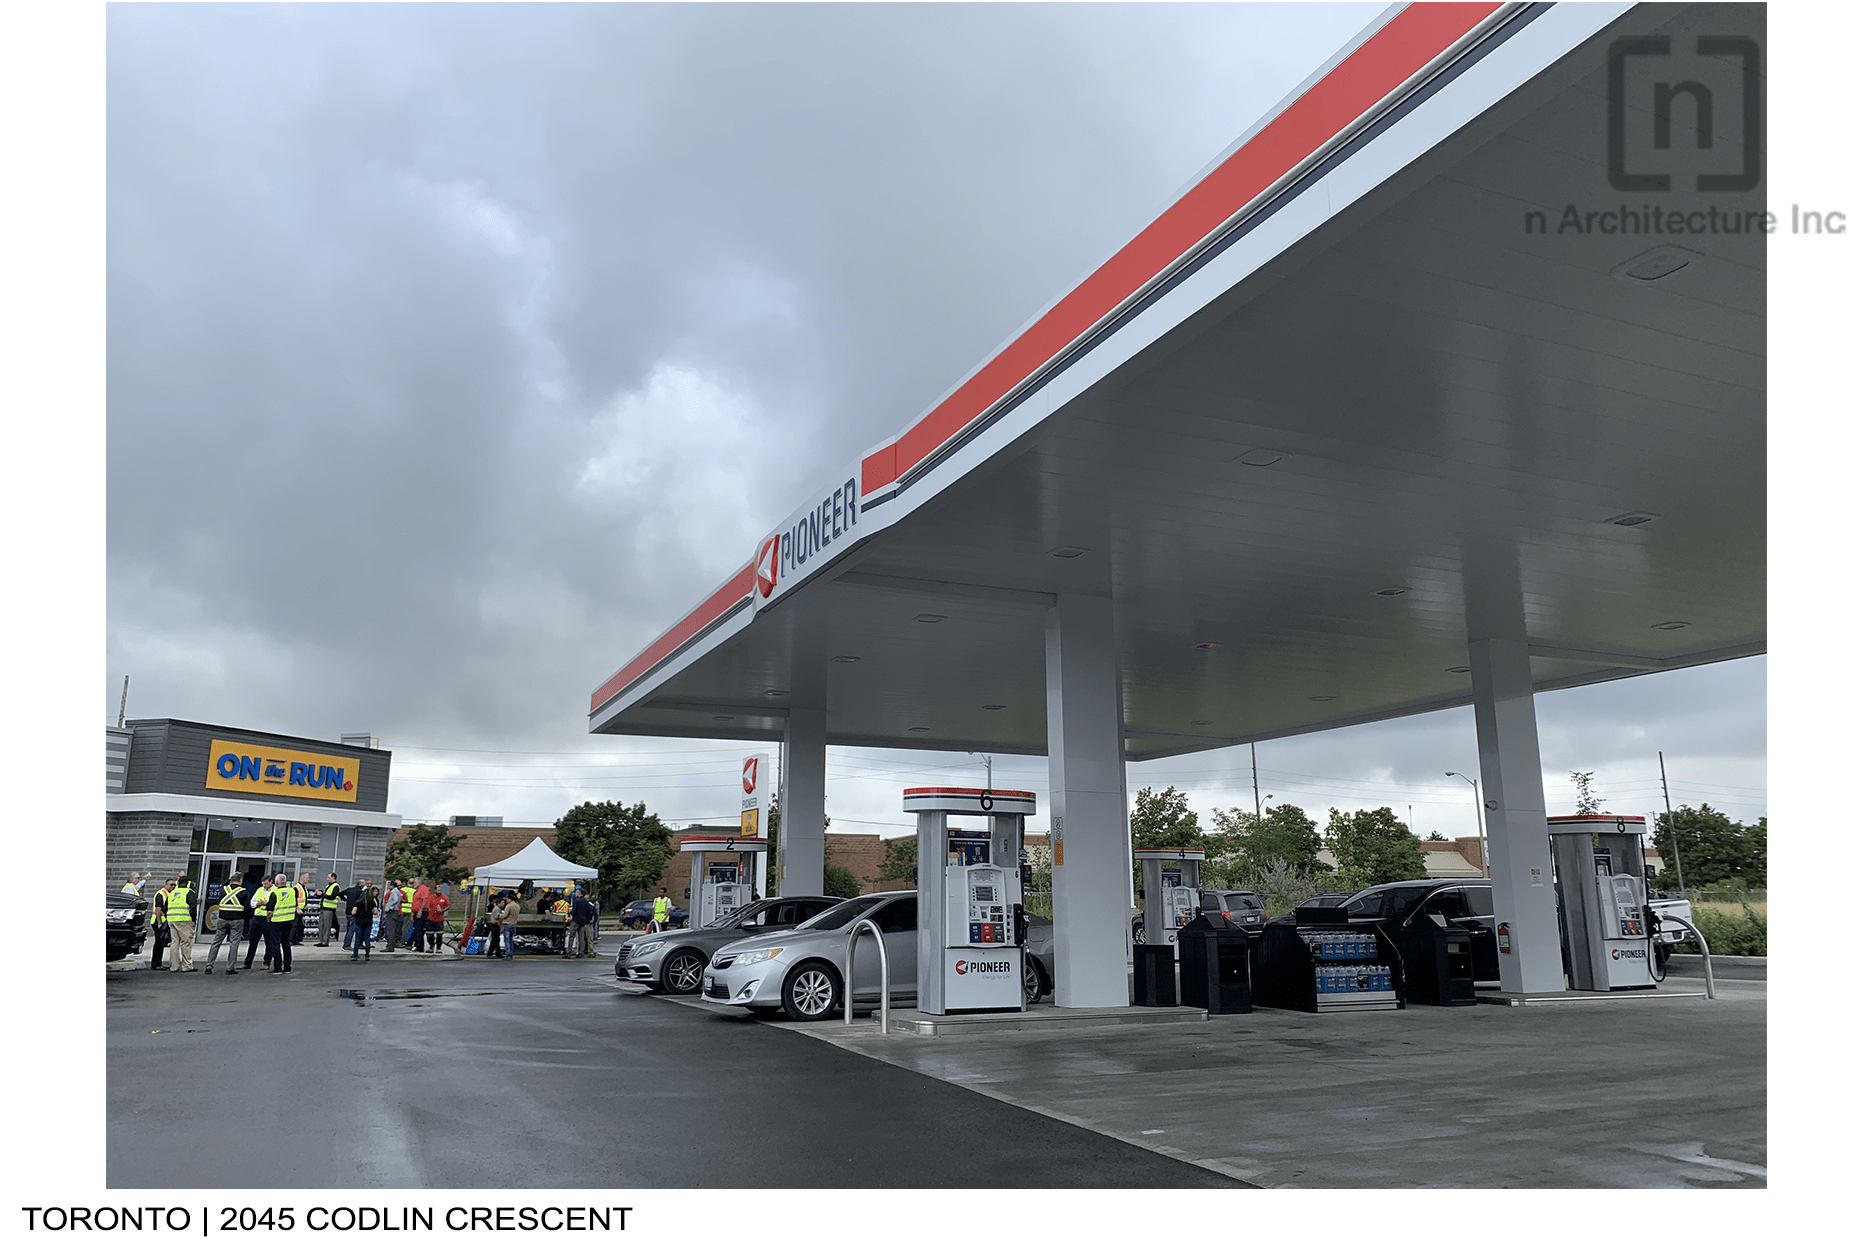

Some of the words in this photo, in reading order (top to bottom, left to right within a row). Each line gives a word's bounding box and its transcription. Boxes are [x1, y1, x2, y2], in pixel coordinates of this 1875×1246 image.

[781, 477, 858, 578] PIONEER
[217, 753, 262, 781] ON
[265, 764, 286, 778] the
[289, 761, 345, 790] RUN
[980, 789, 994, 811] 6
[1617, 816, 1626, 833] 8
[726, 837, 735, 850] 2
[1179, 848, 1186, 859] 4
[1621, 950, 1646, 959] PIONEER
[970, 962, 1010, 973] PIONEER
